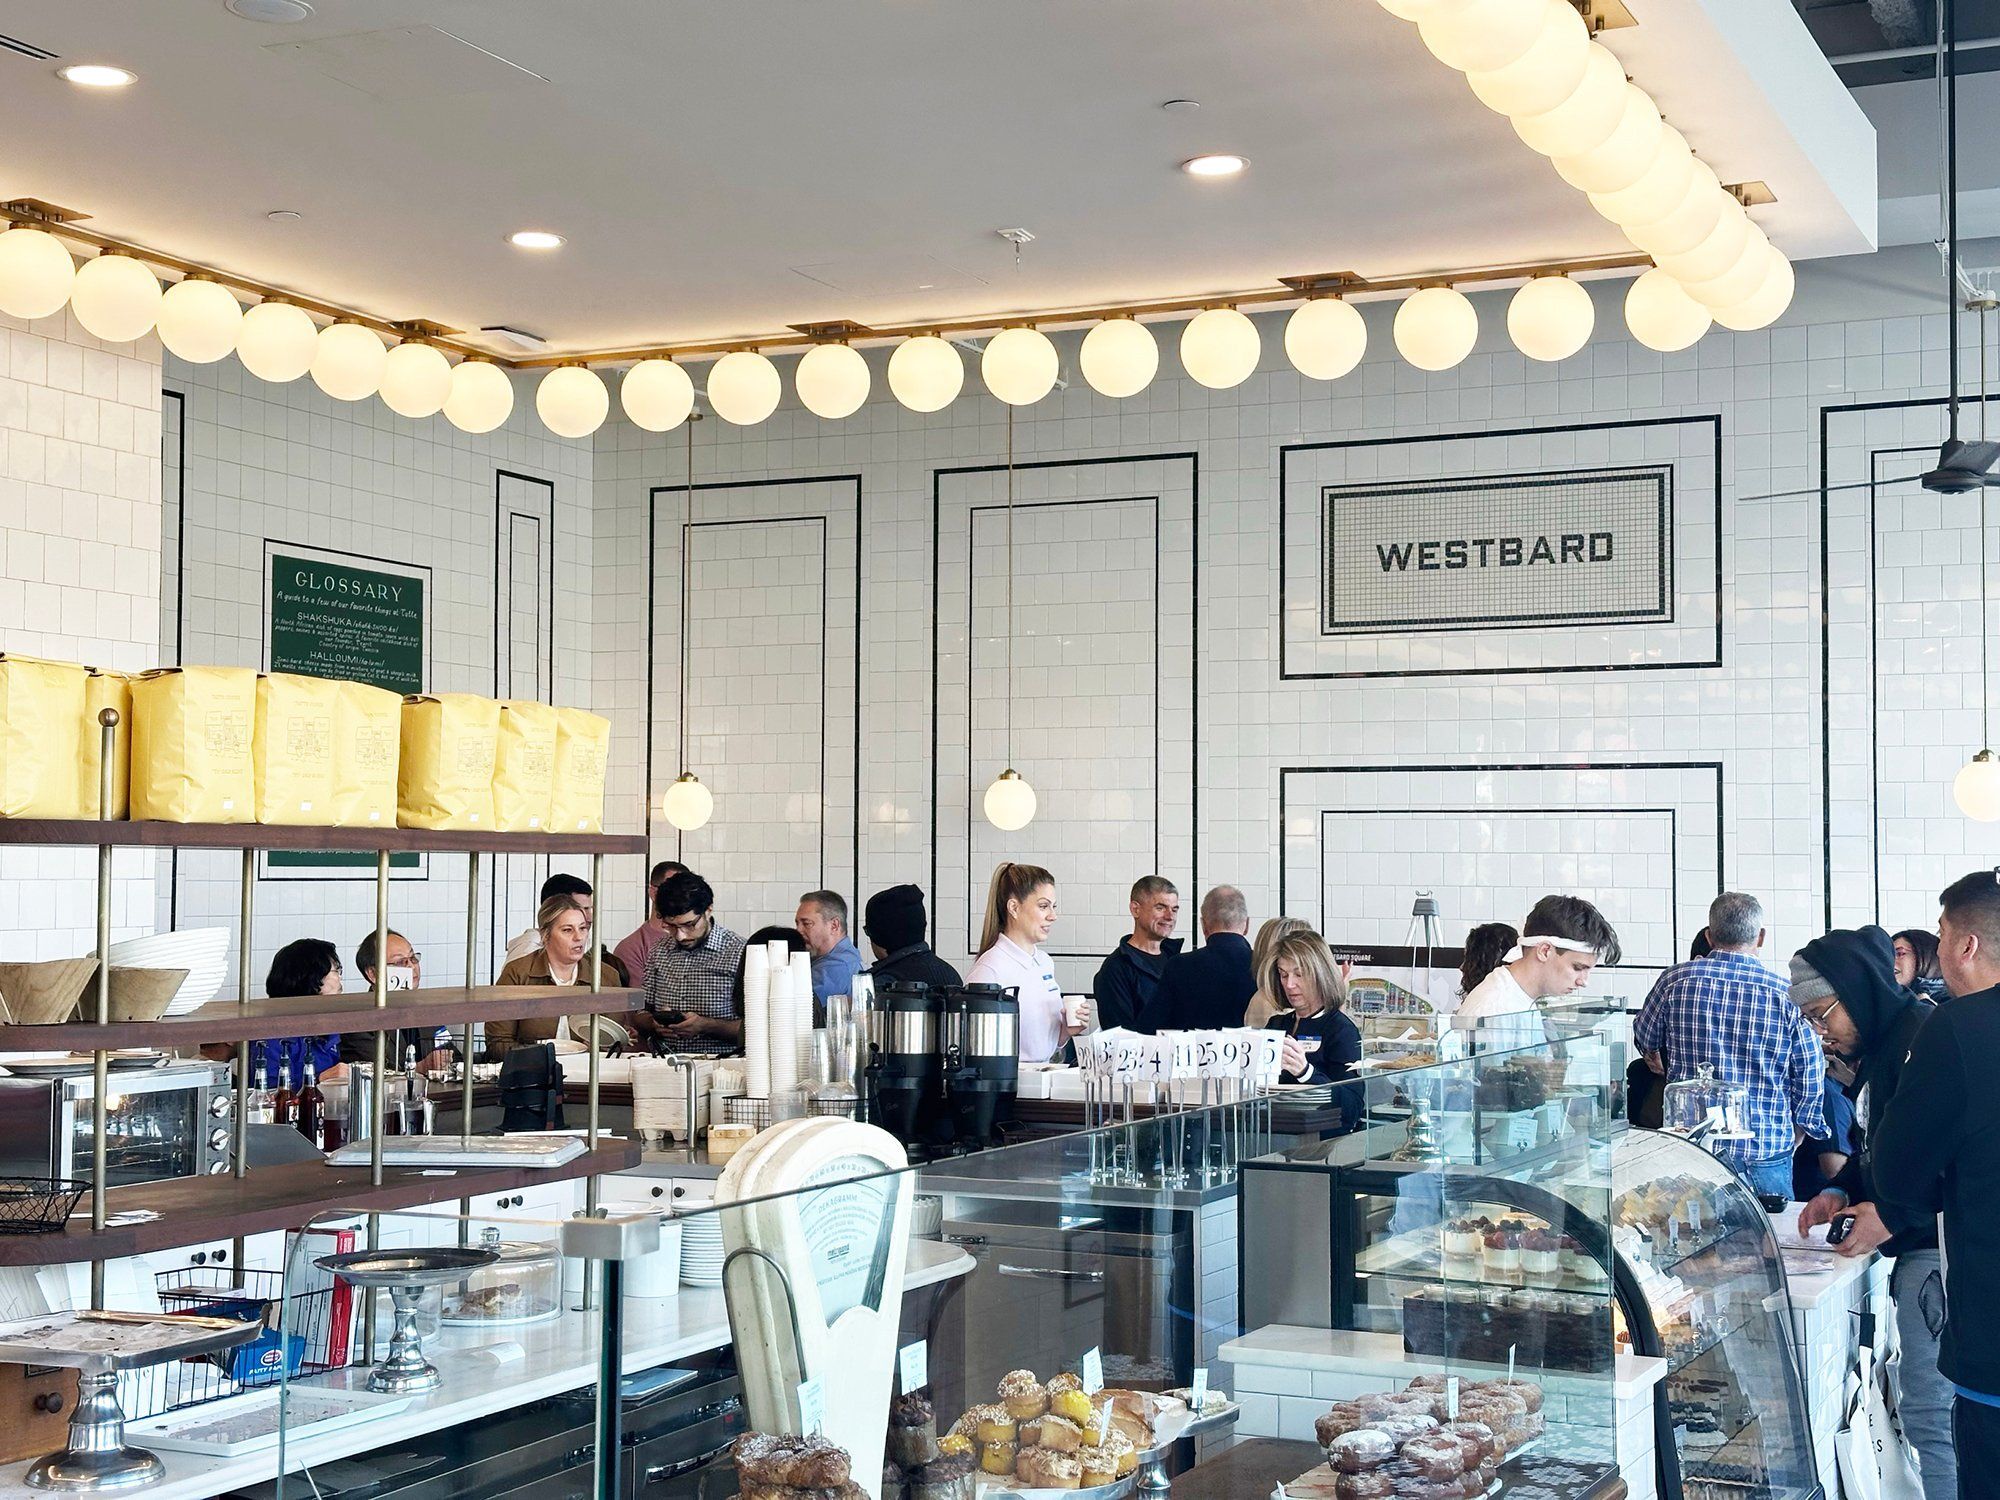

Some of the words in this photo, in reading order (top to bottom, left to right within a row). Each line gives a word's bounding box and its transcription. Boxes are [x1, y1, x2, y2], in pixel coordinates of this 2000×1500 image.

[1376, 532, 1613, 572] WESTBARD
[276, 590, 282, 598] A
[296, 572, 401, 601] GLOSSARY
[390, 976, 409, 990] 24
[1149, 1045, 1161, 1072] 4
[1176, 1045, 1191, 1066] 11
[1197, 1043, 1217, 1067] 25
[1223, 1043, 1237, 1066] 9
[1264, 1039, 1275, 1064] 5
